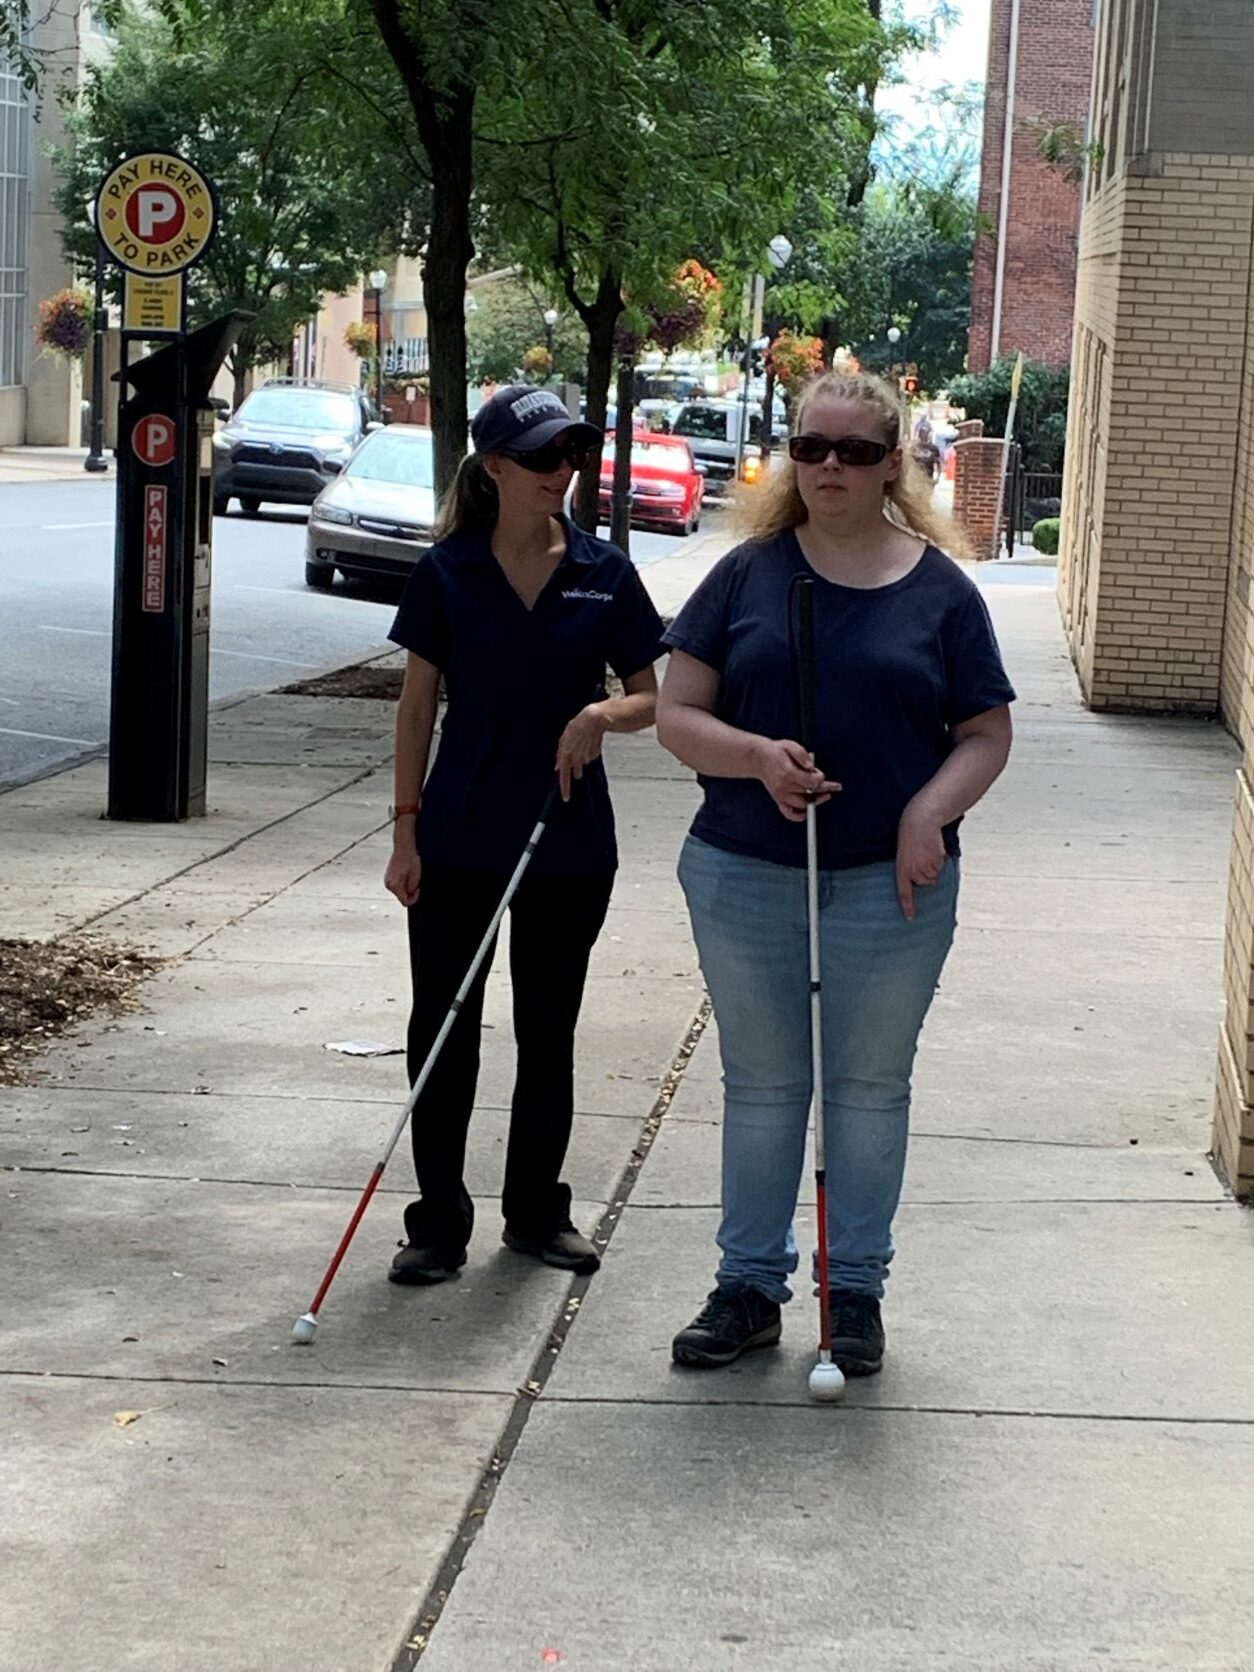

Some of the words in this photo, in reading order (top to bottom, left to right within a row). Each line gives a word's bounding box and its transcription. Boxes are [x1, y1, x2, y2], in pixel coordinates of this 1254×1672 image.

[108, 164, 140, 199] PAY
[150, 160, 203, 199] HERE
[137, 190, 177, 236] P
[113, 232, 139, 260] TO
[146, 232, 200, 267] PARK
[146, 424, 168, 458] P
[148, 490, 163, 538] PAY
[147, 543, 162, 606] HERE
